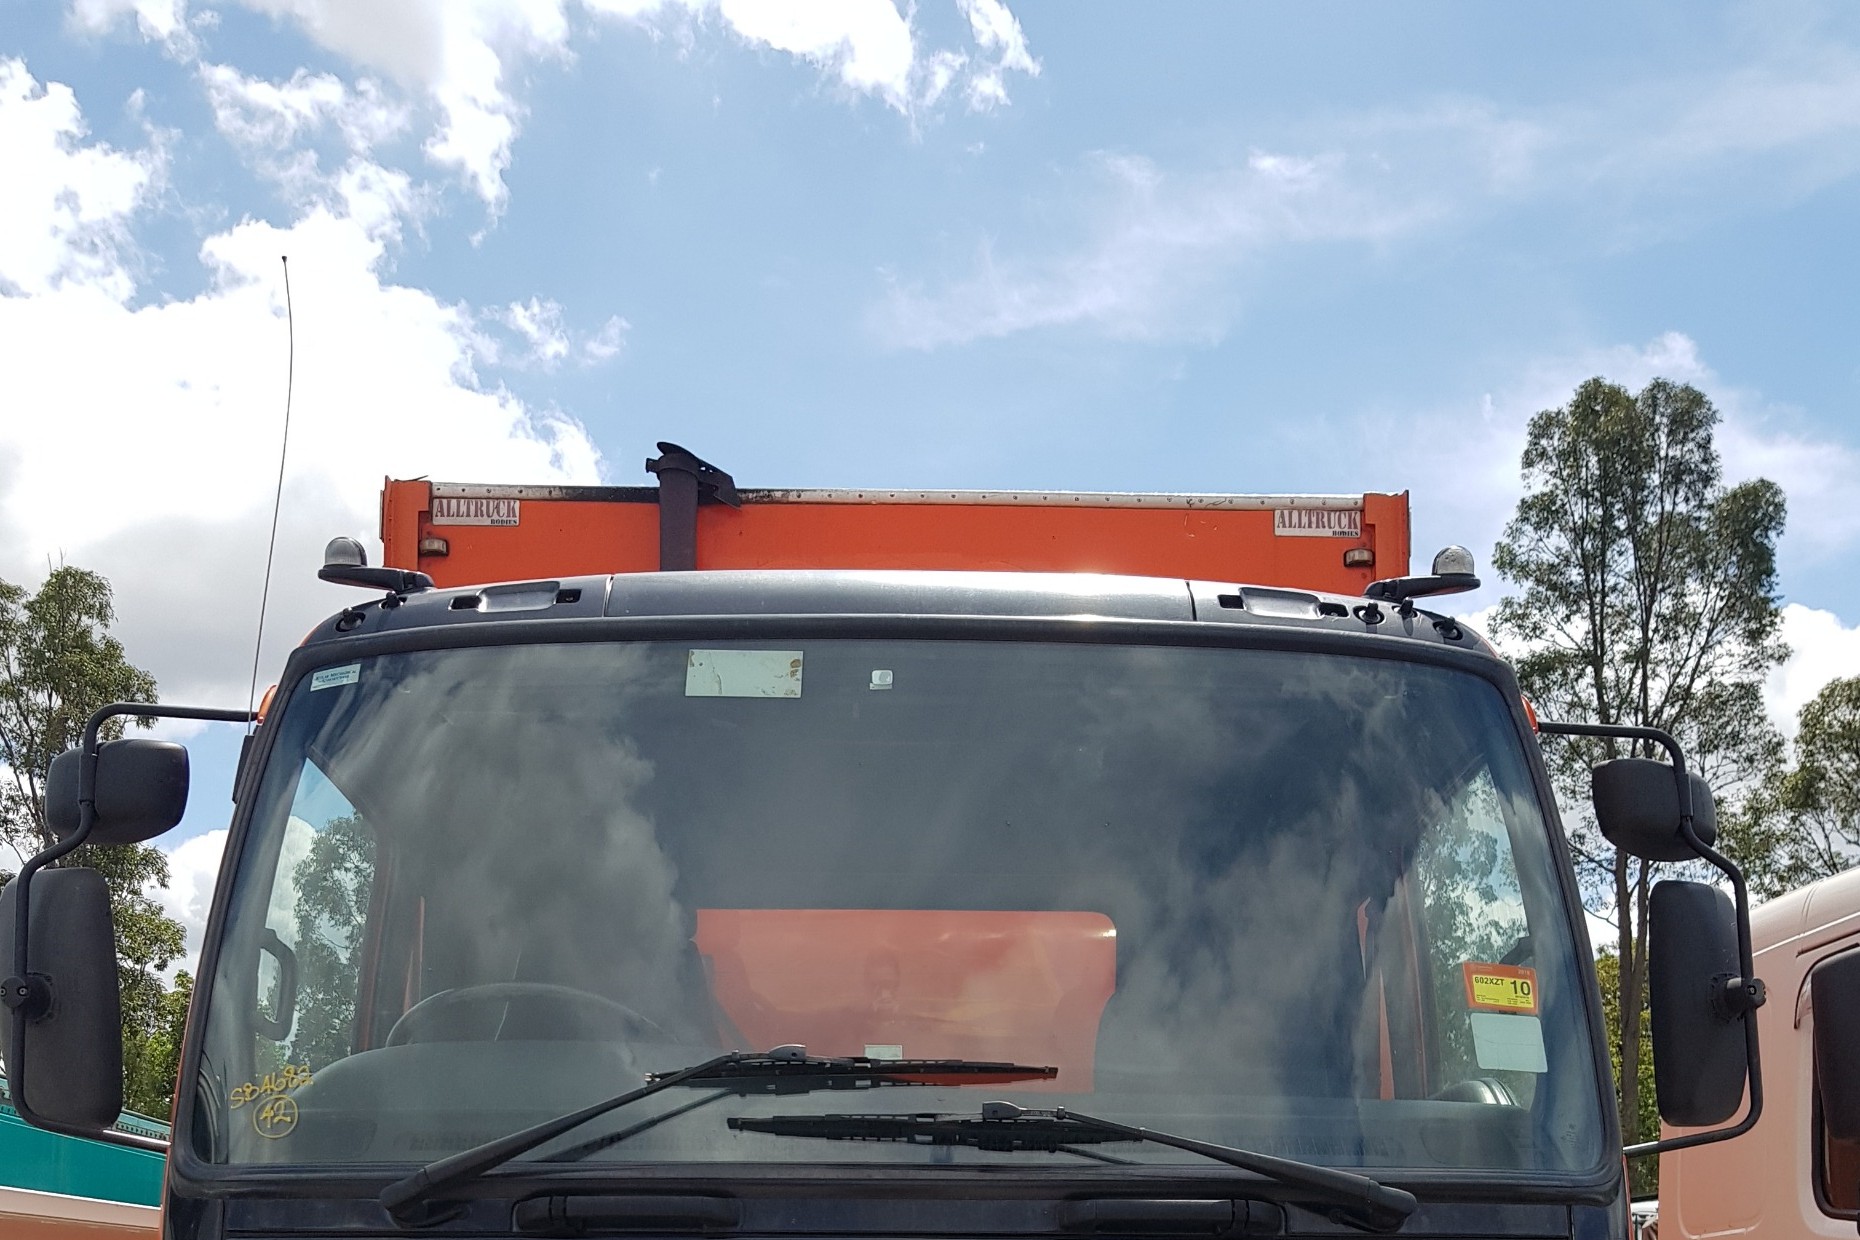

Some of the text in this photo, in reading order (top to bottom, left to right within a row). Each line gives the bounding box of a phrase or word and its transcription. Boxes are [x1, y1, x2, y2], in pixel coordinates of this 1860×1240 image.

[435, 500, 517, 518] ALLTRUCK
[1276, 510, 1358, 530] ALLTRUCK
[1474, 976, 1530, 996] 602XZT 10
[260, 1100, 292, 1129] 42
